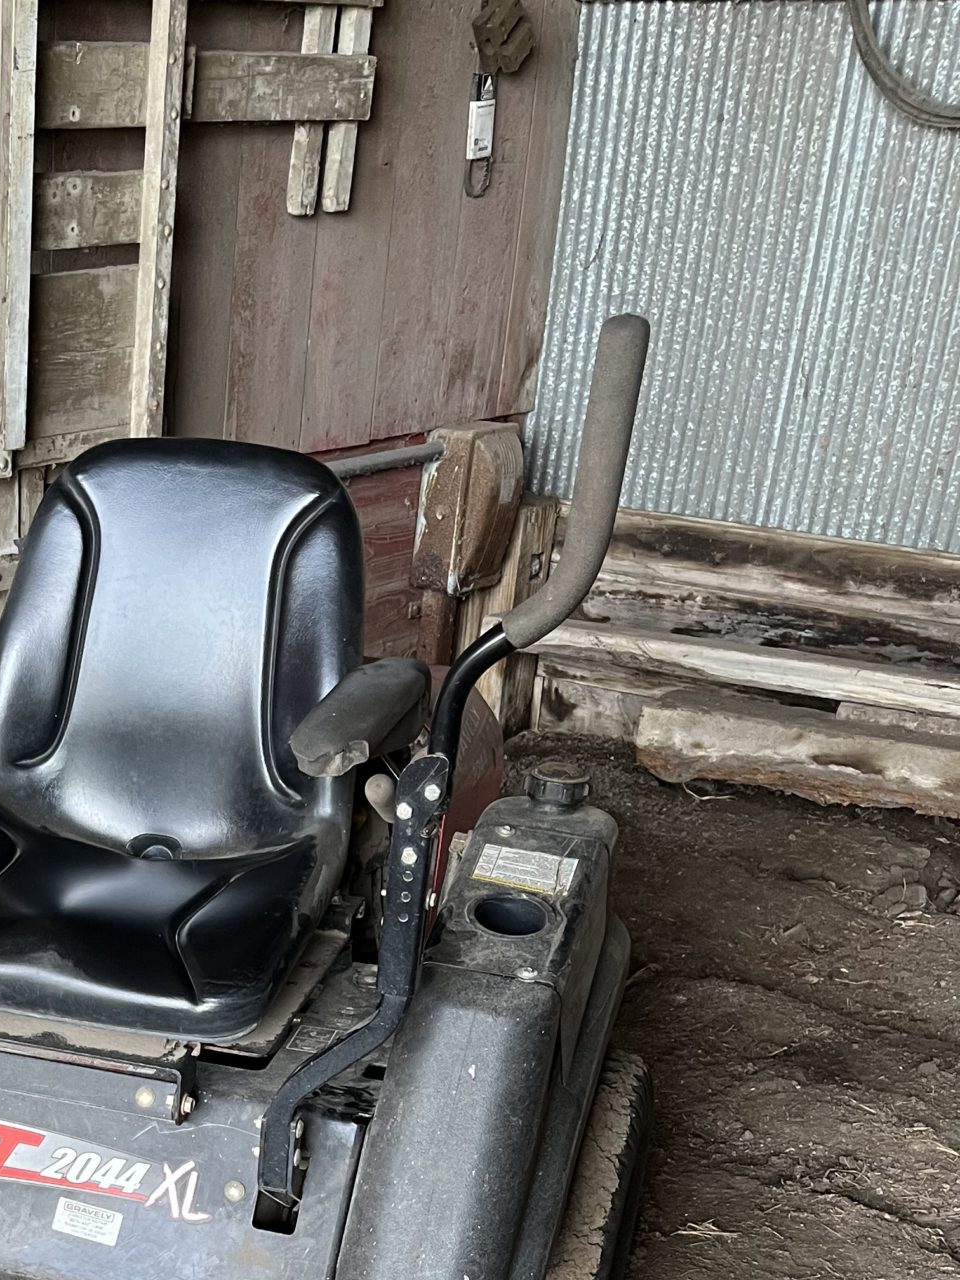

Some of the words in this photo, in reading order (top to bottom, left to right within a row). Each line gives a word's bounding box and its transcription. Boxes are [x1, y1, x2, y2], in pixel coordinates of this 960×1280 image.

[40, 1147, 151, 1194] 2044
[145, 1160, 213, 1221] XL
[65, 1203, 112, 1220] GRAVELY
